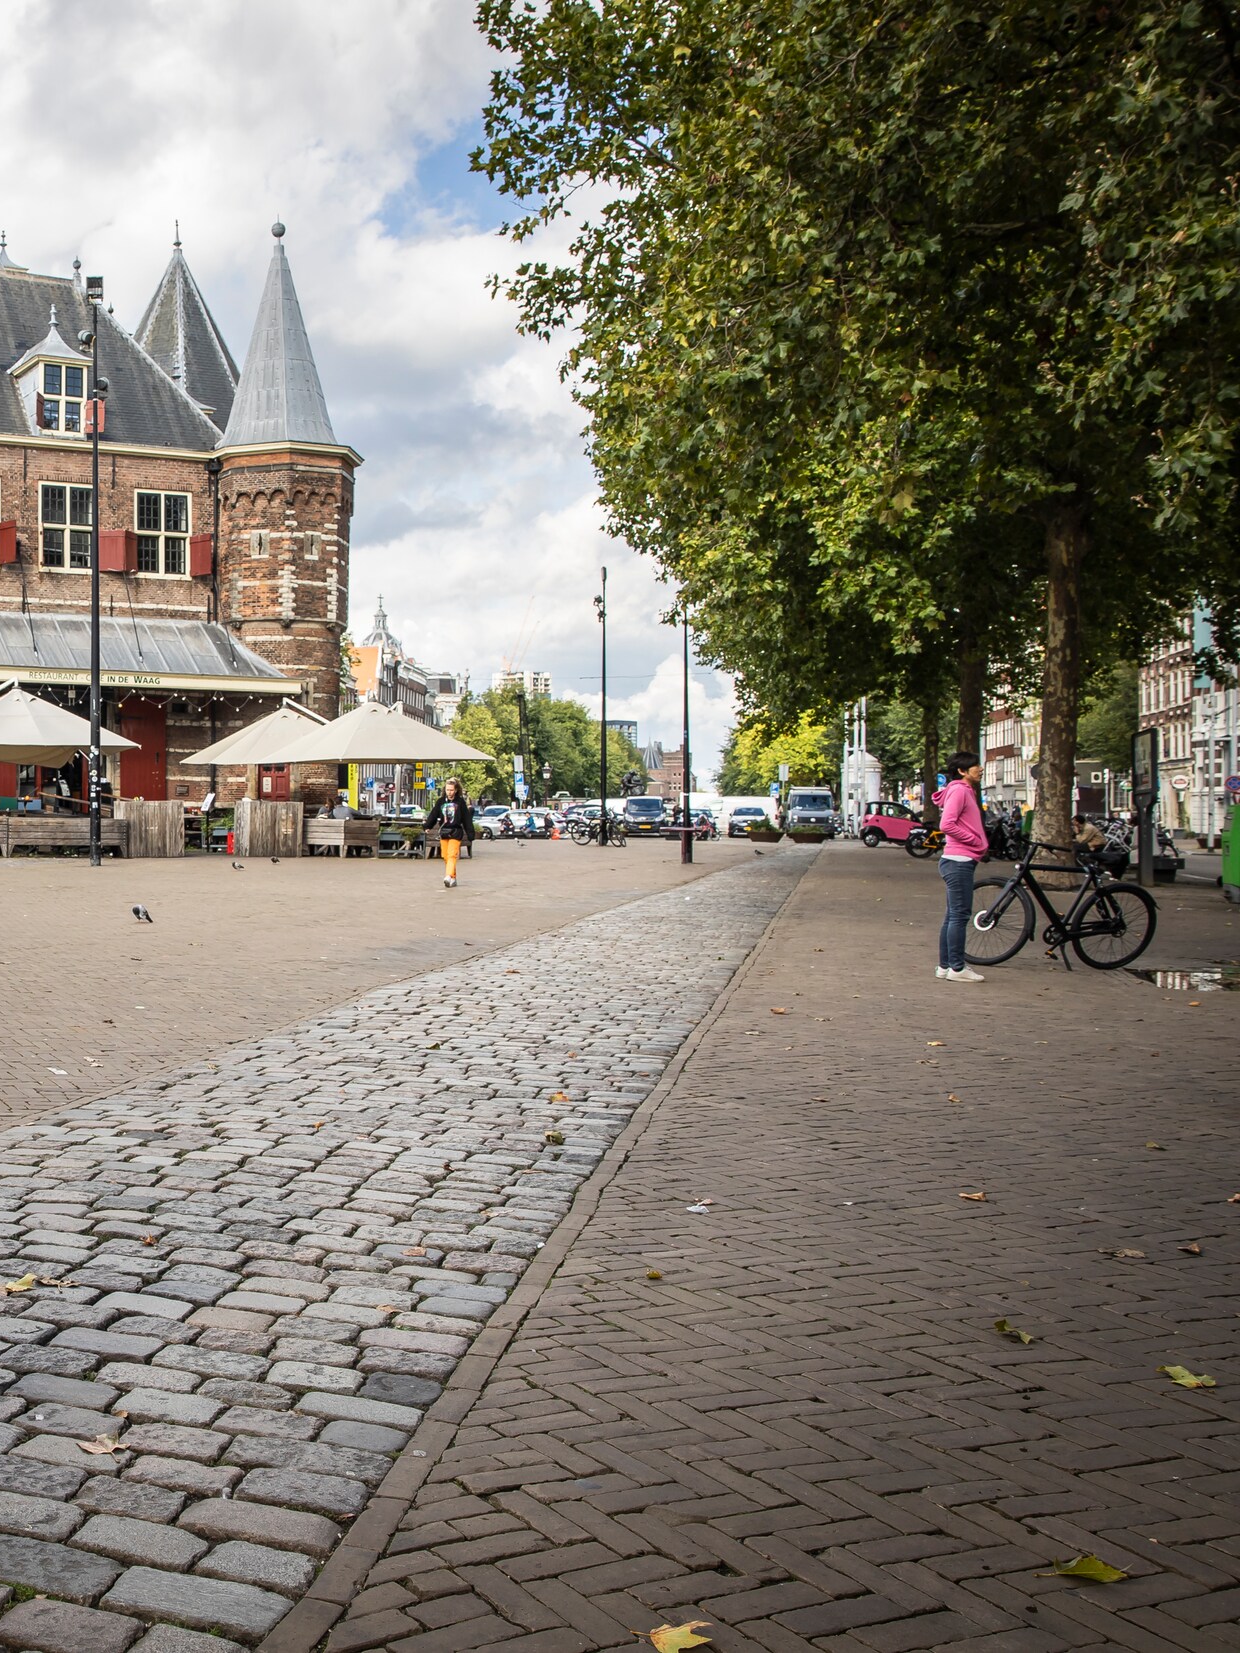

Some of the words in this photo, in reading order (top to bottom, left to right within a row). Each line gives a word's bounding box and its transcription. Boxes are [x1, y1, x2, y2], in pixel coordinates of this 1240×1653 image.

[29, 672, 78, 681] RESTAURANT
[86, 672, 104, 682] CÉ
[107, 675, 115, 683] IN
[134, 675, 160, 685] WAAG
